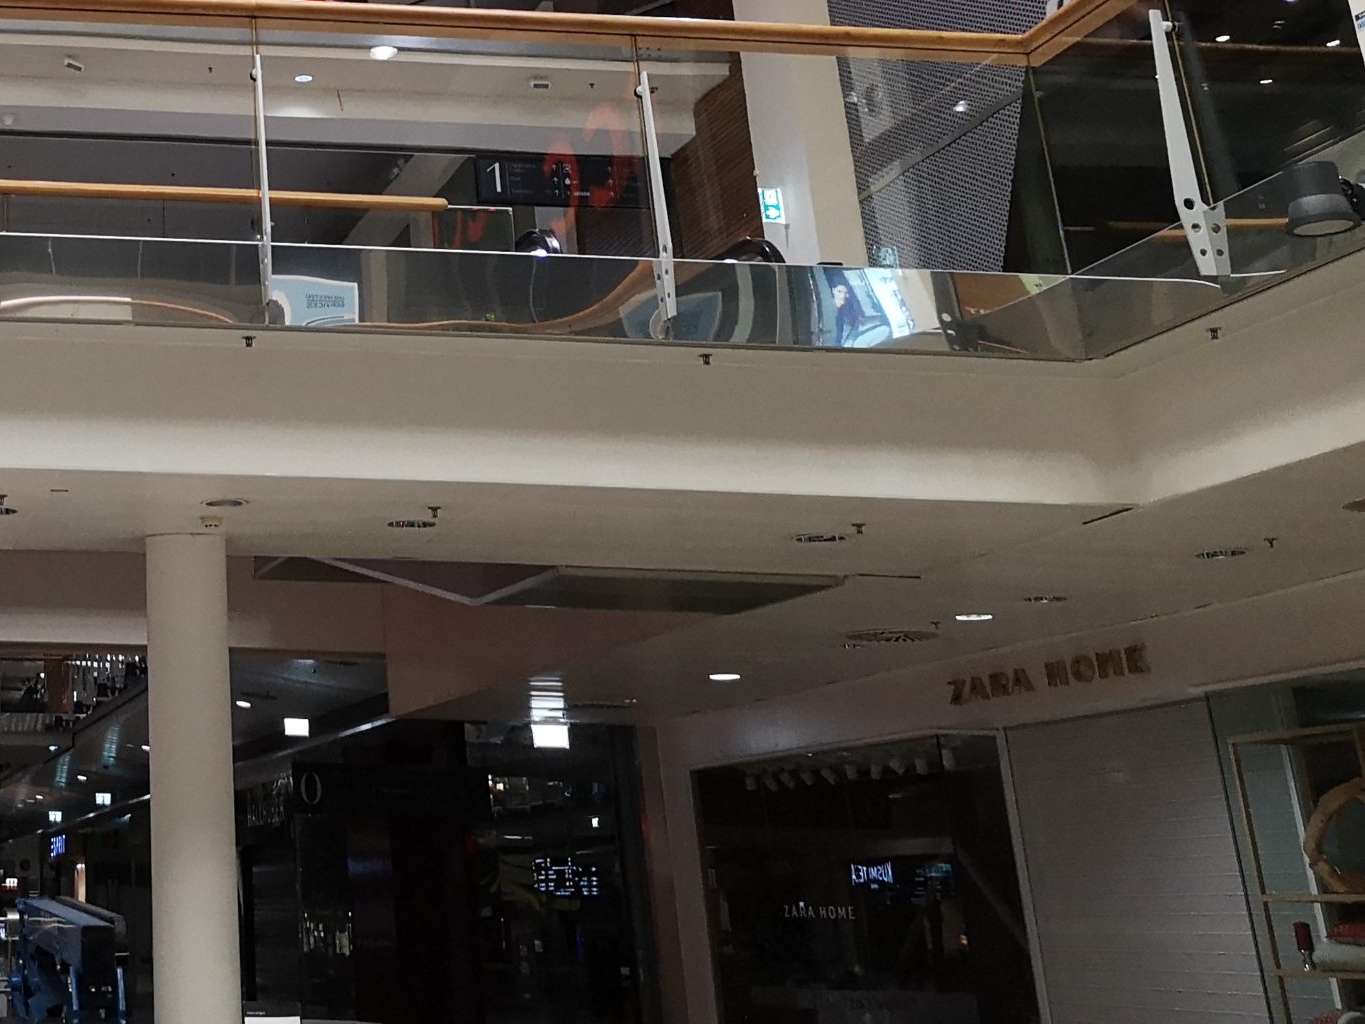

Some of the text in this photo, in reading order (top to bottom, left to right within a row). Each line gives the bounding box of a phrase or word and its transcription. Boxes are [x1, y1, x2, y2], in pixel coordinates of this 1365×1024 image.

[486, 161, 502, 193] 1
[947, 642, 1152, 705] ZARA HOME
[299, 769, 322, 805] 0
[783, 904, 856, 920] ZARA HOME
